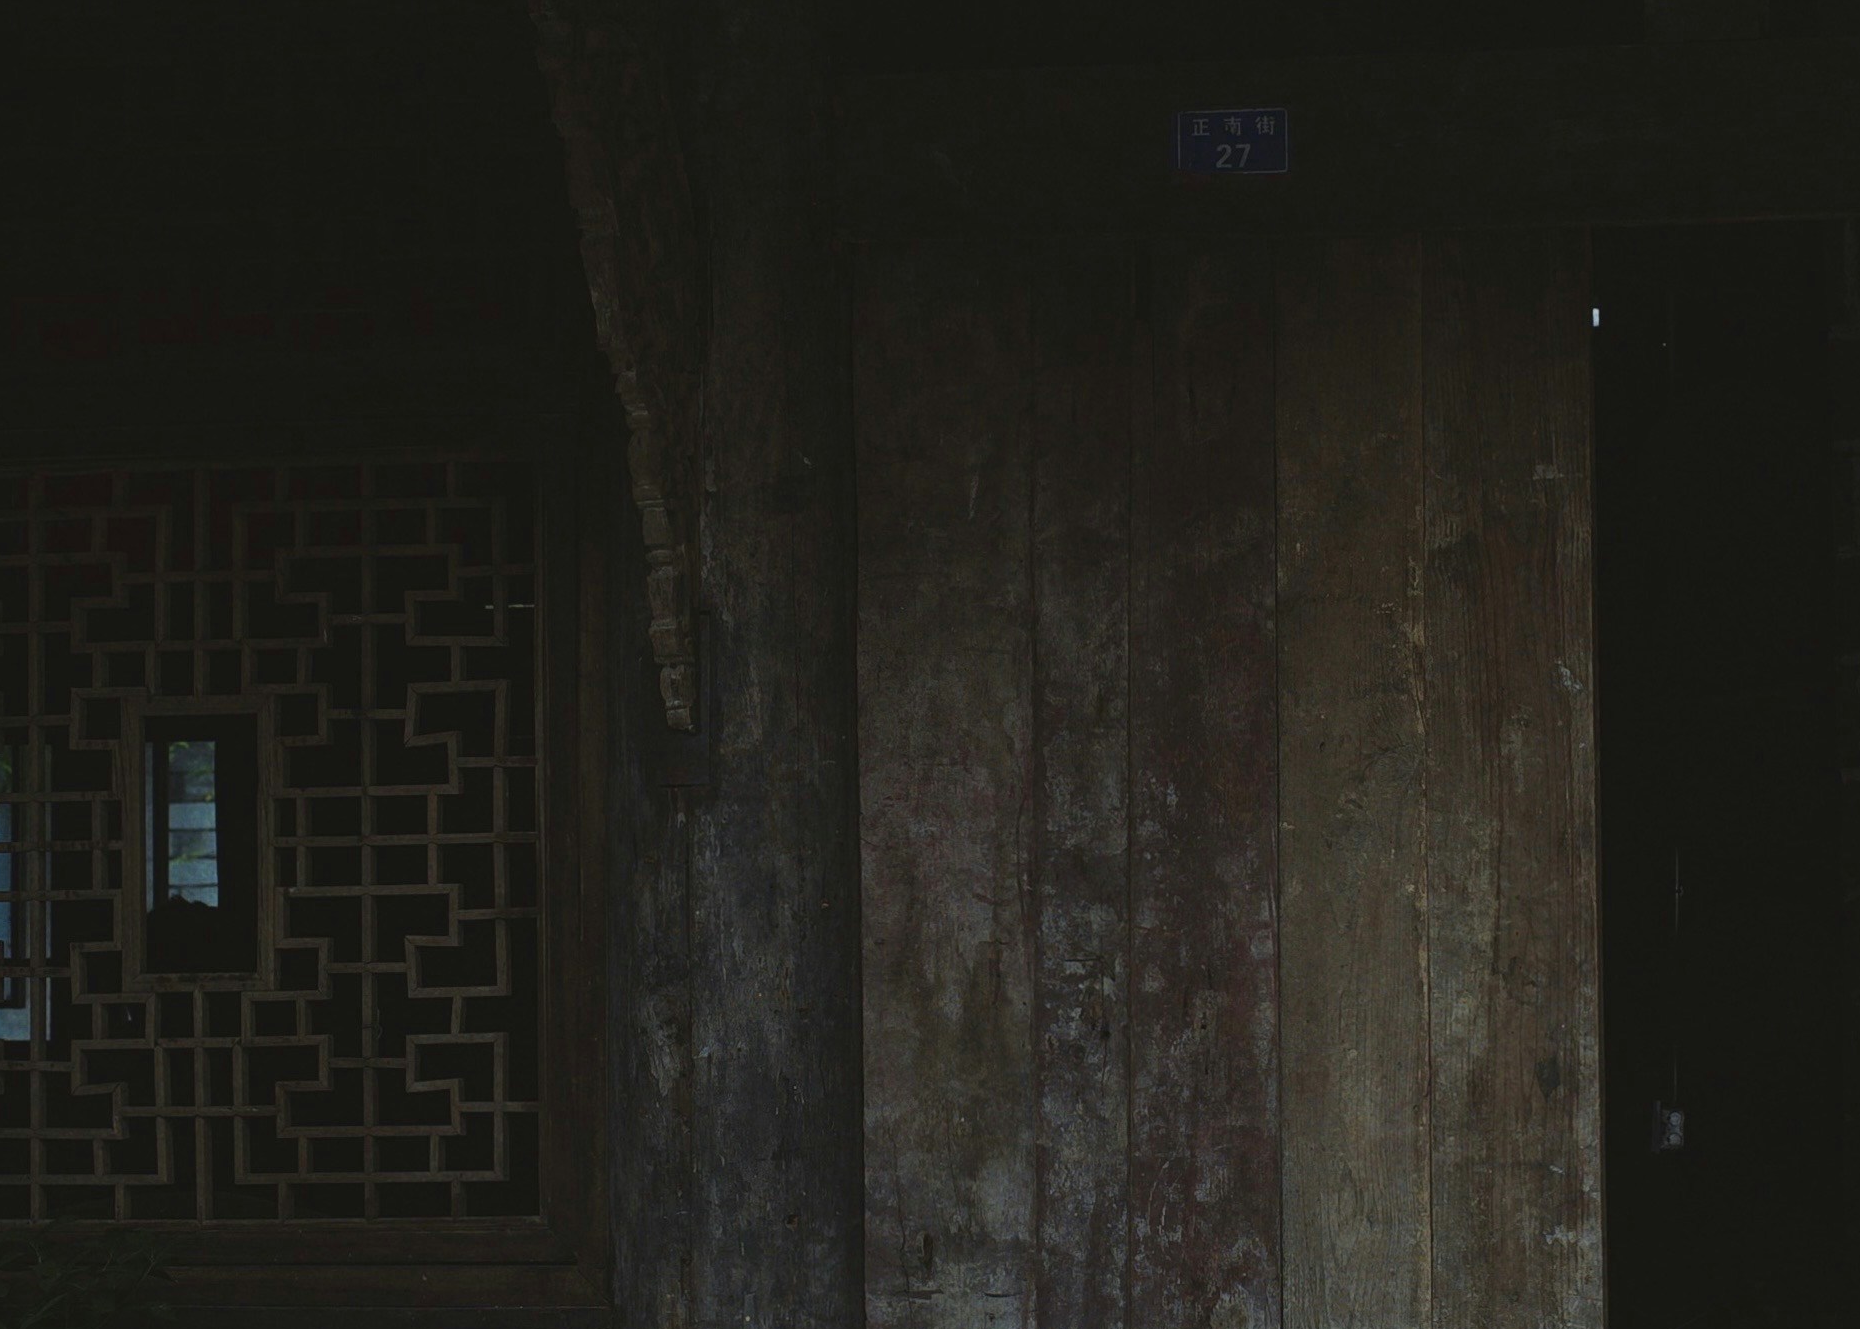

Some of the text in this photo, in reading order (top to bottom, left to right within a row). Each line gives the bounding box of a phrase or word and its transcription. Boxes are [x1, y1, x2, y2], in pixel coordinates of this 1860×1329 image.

[1191, 115, 1275, 136] 正南街
[1215, 143, 1251, 168] 27
